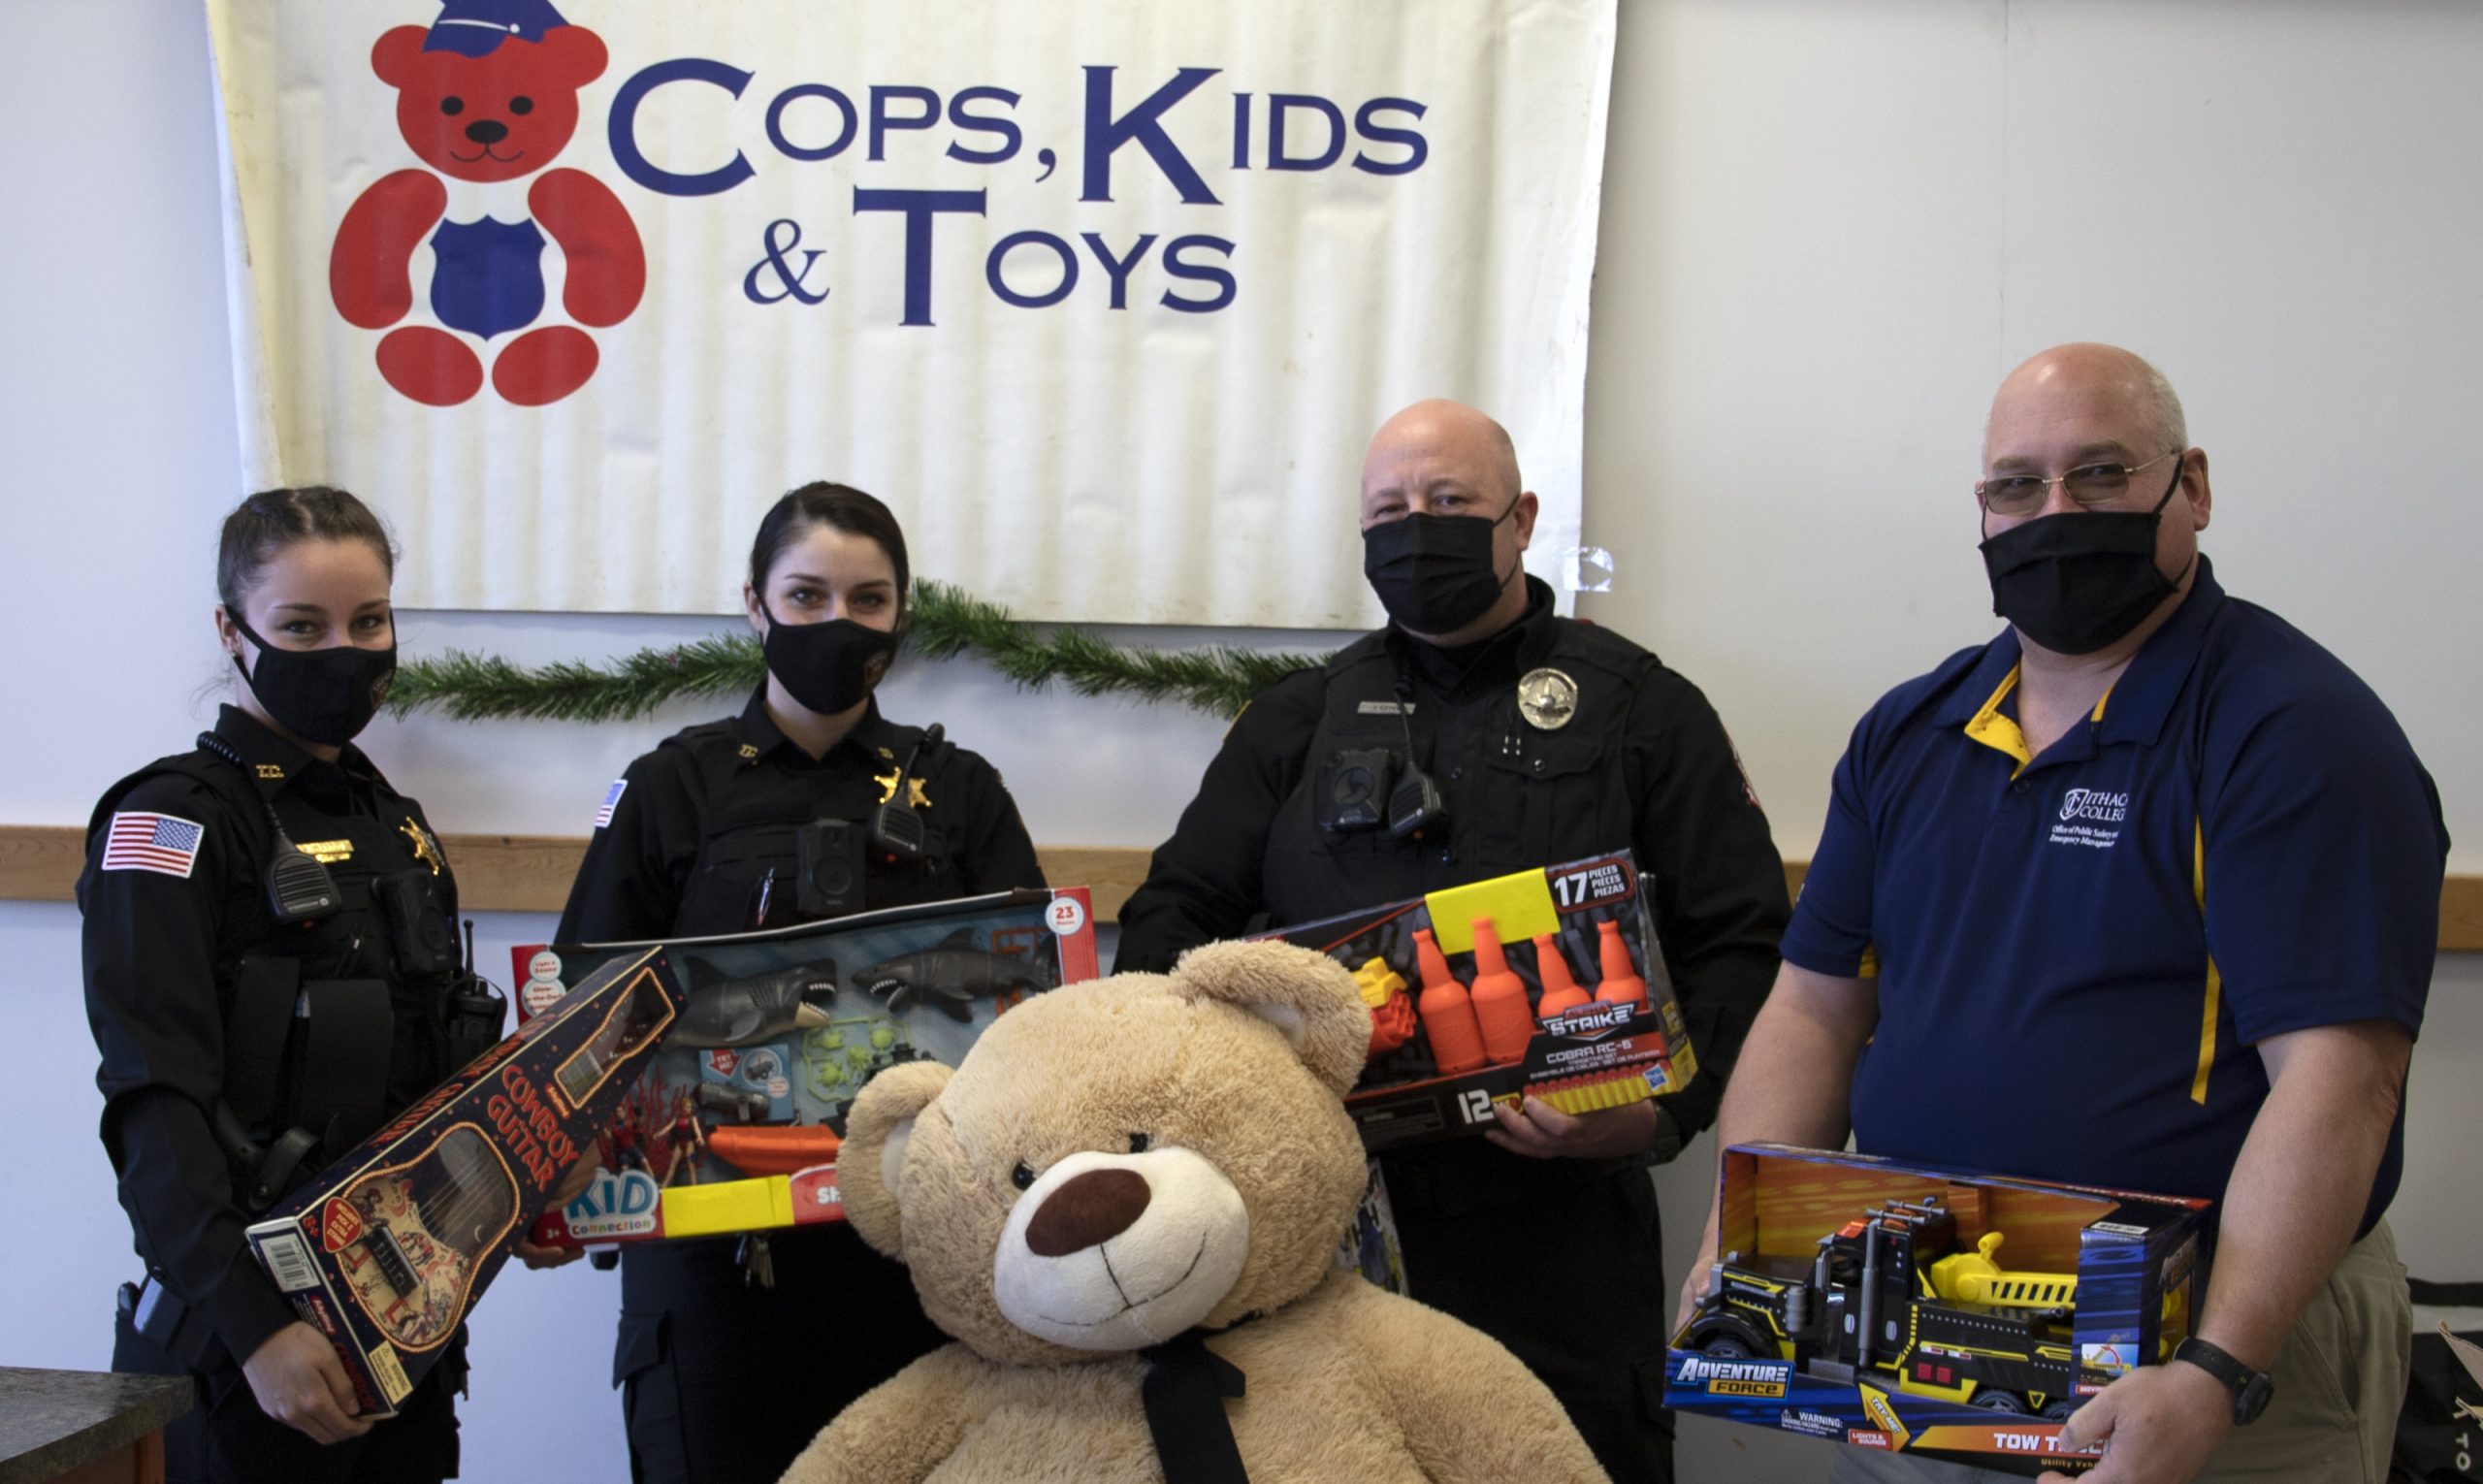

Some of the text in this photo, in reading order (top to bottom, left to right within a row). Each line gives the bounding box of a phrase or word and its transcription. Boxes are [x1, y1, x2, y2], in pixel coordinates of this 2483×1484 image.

[608, 56, 1430, 206] COPS, KIDS
[743, 184, 1238, 327] & TOYS
[2085, 791, 2128, 807] ITHAC
[2079, 805, 2126, 822] COLLEG
[1589, 863, 1619, 880] PIECES
[1555, 871, 1588, 908] 17
[1594, 883, 1626, 899] PIEZAS
[1055, 906, 1074, 919] 23
[1551, 1009, 1630, 1036] STRIKE
[1546, 1047, 1596, 1064] COBRA
[1458, 1088, 1495, 1124] 12
[501, 1064, 580, 1169] COWBOY
[487, 1094, 556, 1193] GUITAR
[566, 1175, 655, 1220] KID
[546, 1227, 561, 1239] 3+
[571, 1219, 652, 1237] Connection
[1676, 1357, 1789, 1382] ADVENTURE
[1799, 1410, 1843, 1429] WARNING:
[1993, 1433, 2041, 1452] TOW
[2040, 1458, 2073, 1468] Utility
